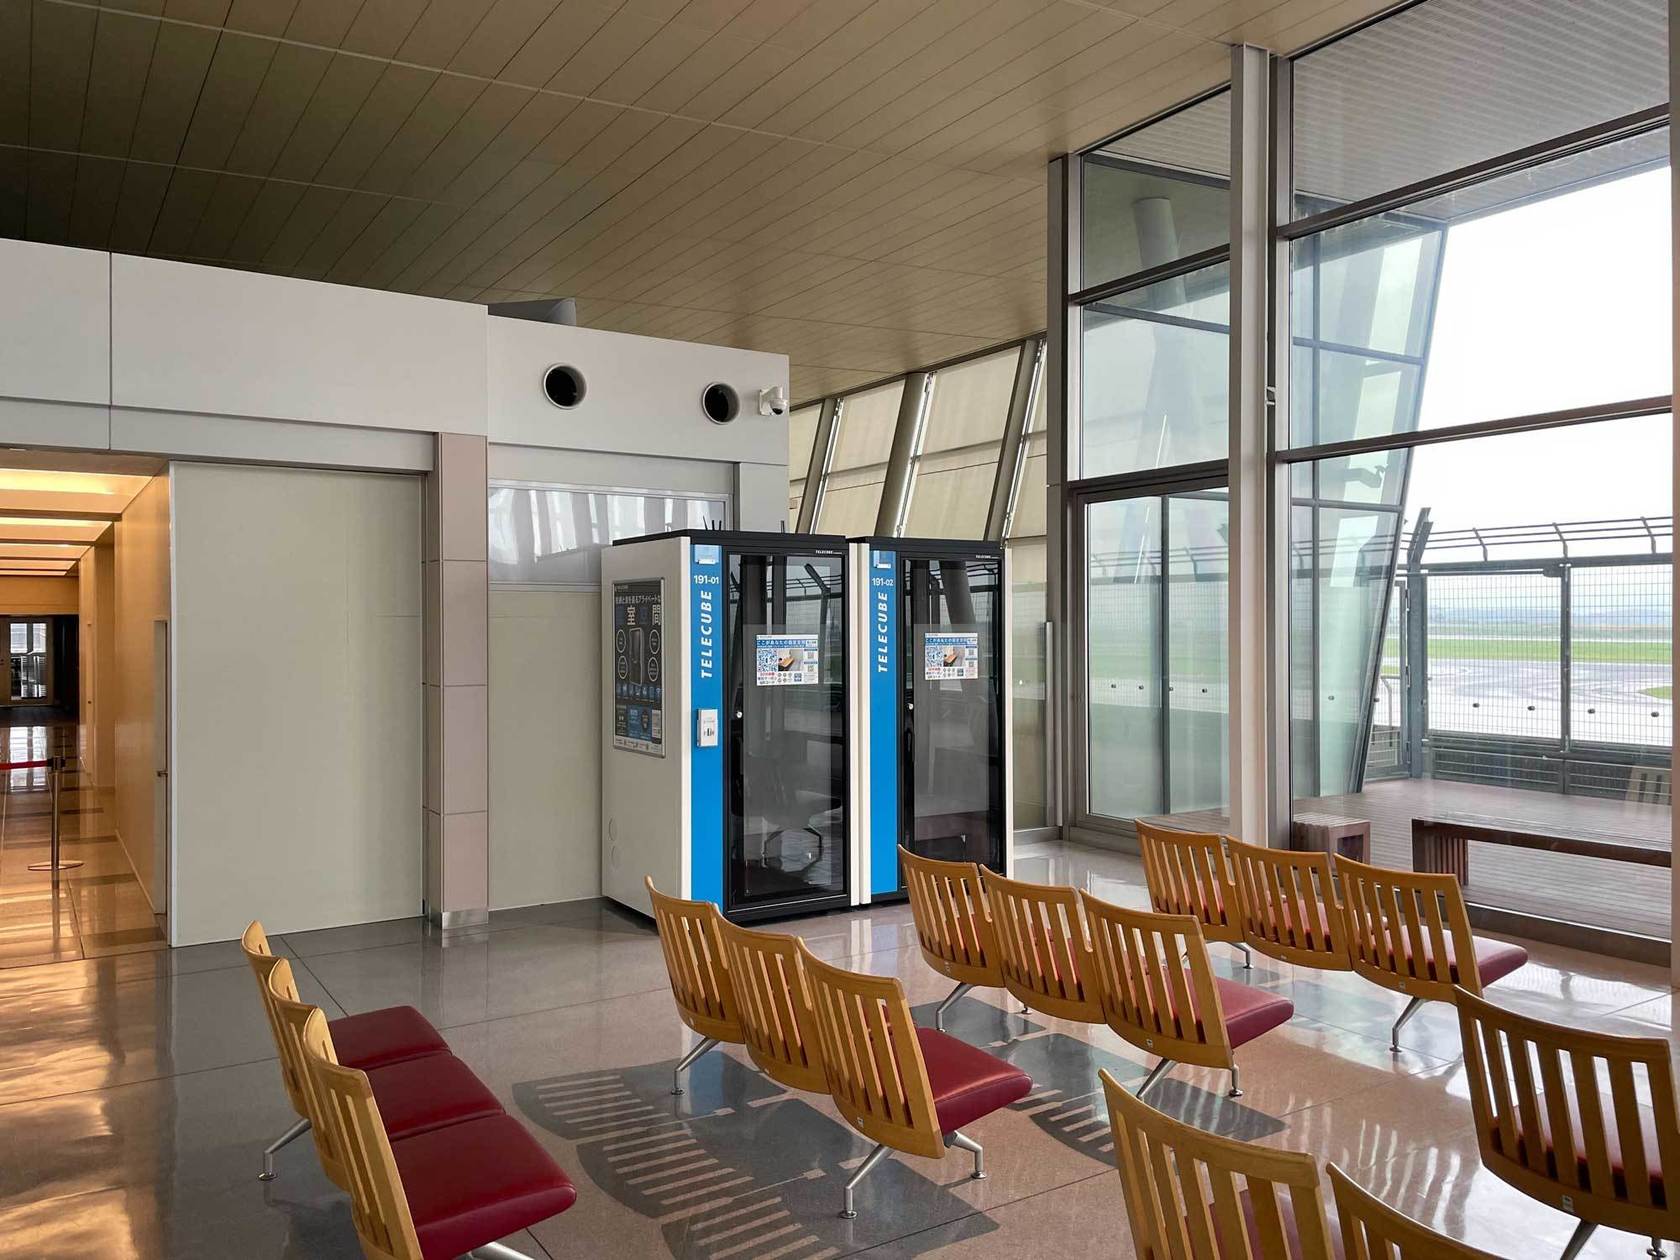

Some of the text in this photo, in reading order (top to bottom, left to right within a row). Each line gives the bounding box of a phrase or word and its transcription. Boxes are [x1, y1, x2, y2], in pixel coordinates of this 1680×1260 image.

[693, 574, 719, 584] 191-01
[872, 577, 894, 586] 191-02
[701, 590, 712, 678] TELECUBE
[878, 592, 888, 673] TELECUBE
